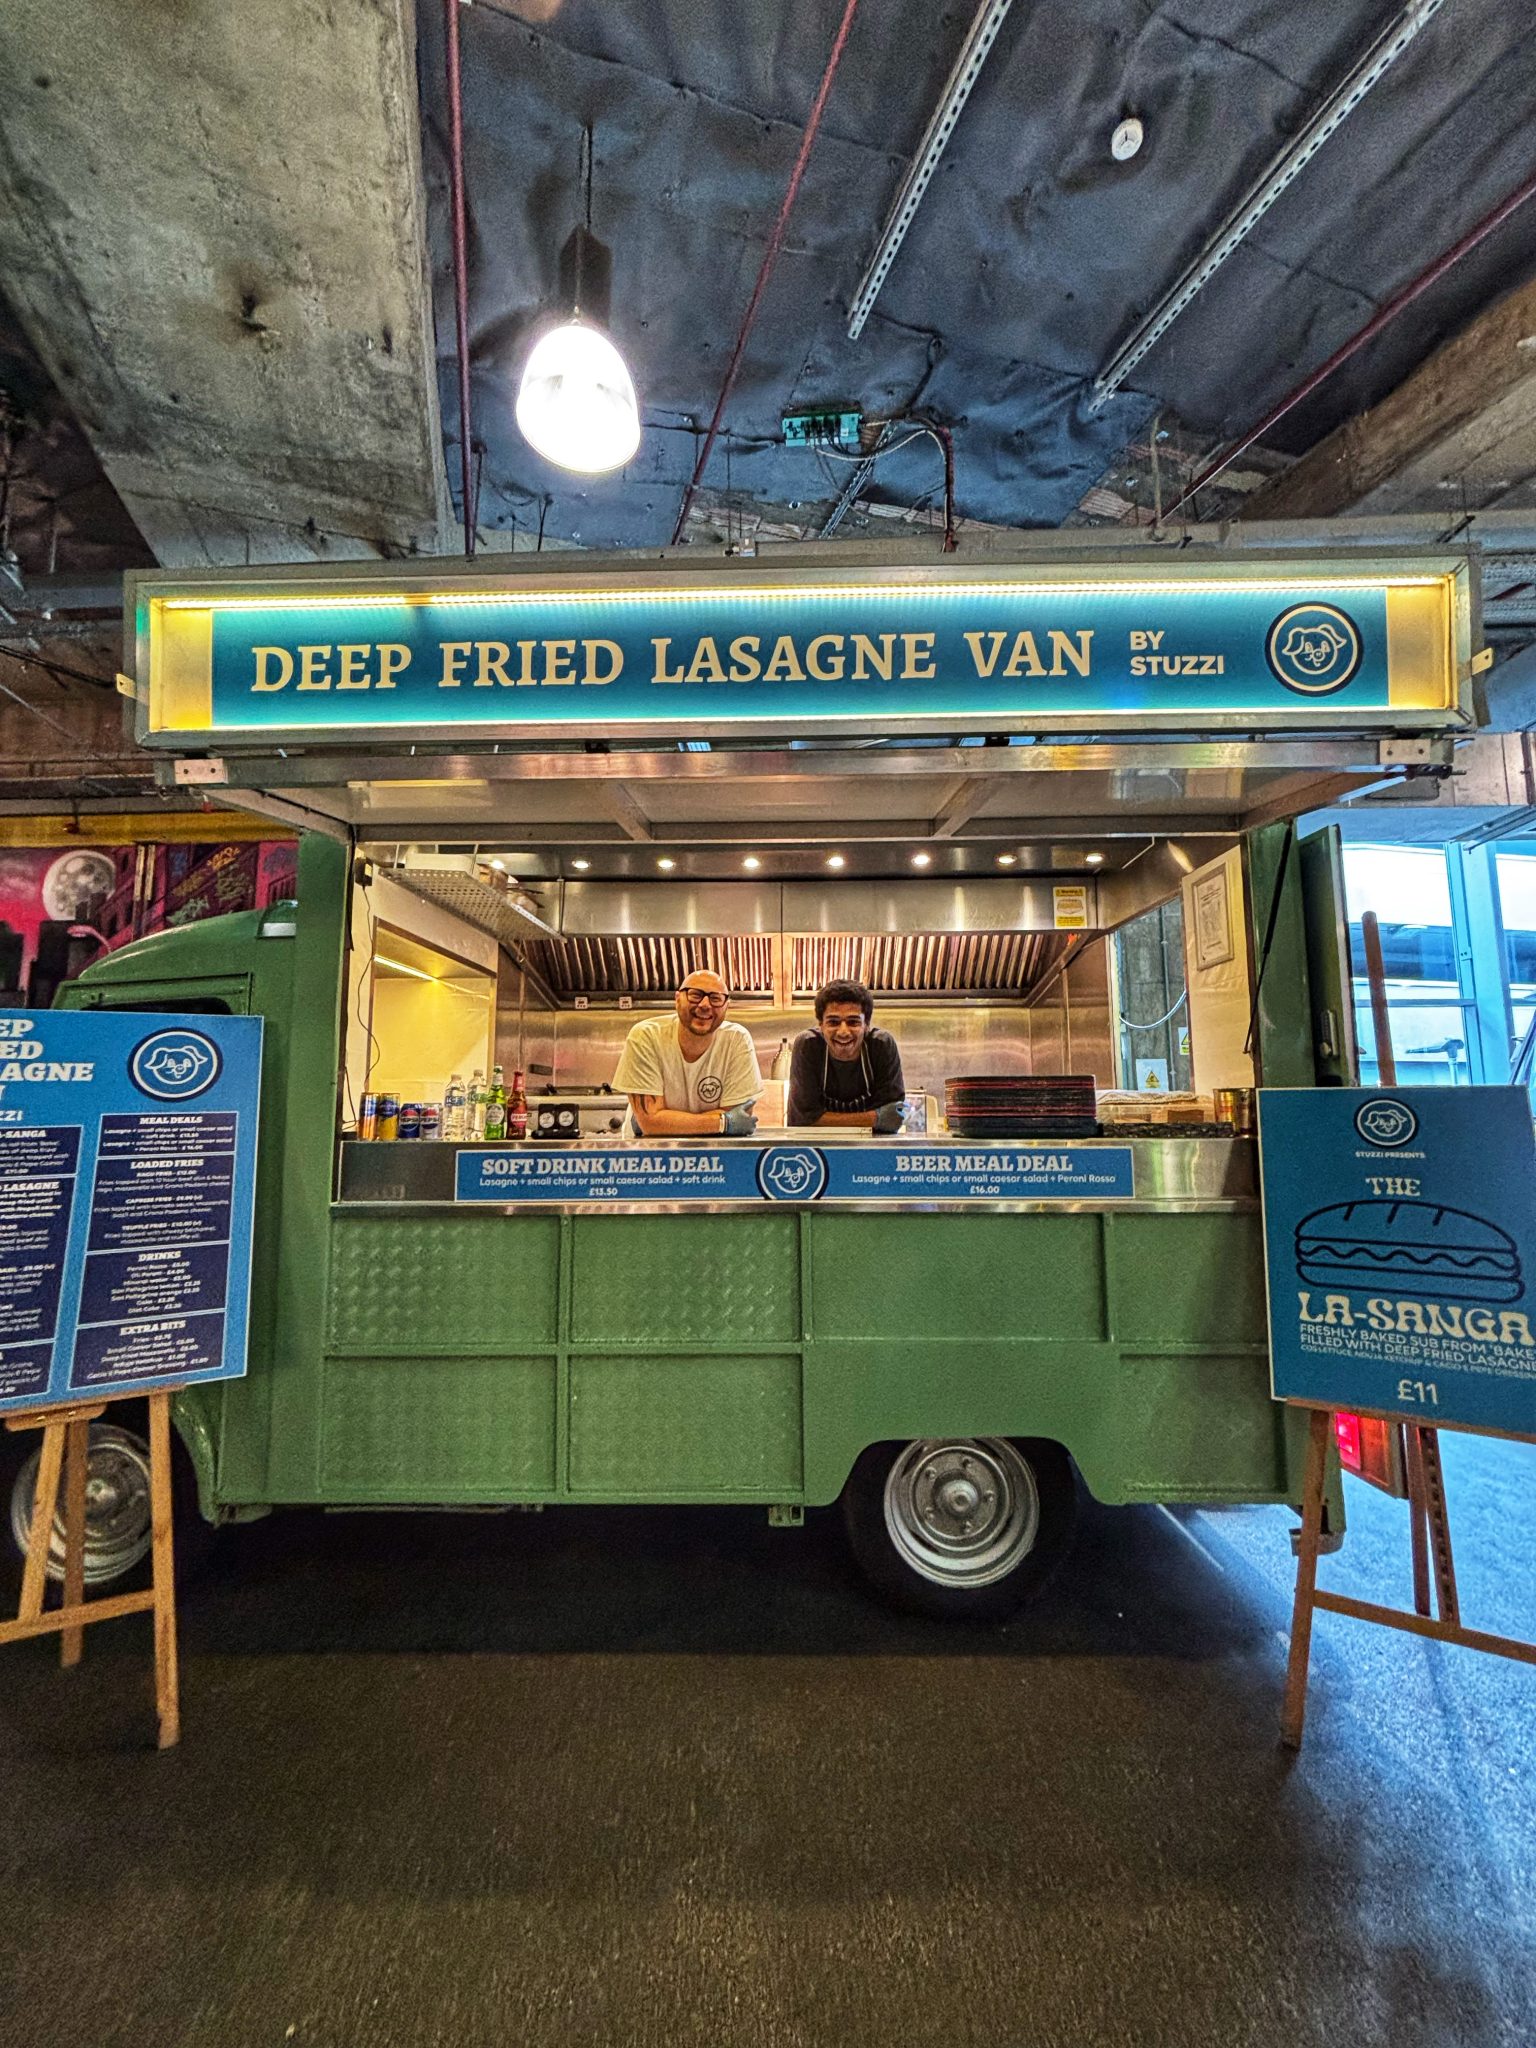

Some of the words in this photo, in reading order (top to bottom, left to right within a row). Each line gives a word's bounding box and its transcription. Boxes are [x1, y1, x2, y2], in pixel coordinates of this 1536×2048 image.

[1129, 630, 1166, 651] BY
[251, 643, 412, 692] DEEP
[438, 639, 625, 688] FRIED
[651, 631, 937, 685] LASAGNE
[963, 630, 1095, 678] VAN
[1129, 655, 1226, 676] STUZZI
[139, 1117, 168, 1125] MEAL
[170, 1116, 203, 1124] DEALS
[0, 1130, 46, 1138] -SANGA
[1385, 1151, 1426, 1159] PRESENTS
[130, 1160, 174, 1169] LOADED
[174, 1159, 204, 1167] FRIES
[482, 1158, 535, 1176] SOFT
[536, 1158, 606, 1175] DRINK
[608, 1157, 666, 1174] MEAL
[669, 1156, 724, 1173] DEAL
[896, 1155, 952, 1172] BEER
[954, 1155, 1013, 1172] MEAL
[1016, 1155, 1073, 1172] DEAL
[2, 1181, 60, 1191] LASAGNE
[480, 1177, 518, 1188] Lasagne
[527, 1177, 552, 1185] small
[553, 1177, 576, 1187] chips
[590, 1176, 614, 1185] small
[616, 1177, 646, 1185] caesar
[648, 1175, 673, 1184] salad
[682, 1175, 700, 1184] soft
[701, 1175, 726, 1184] drink
[852, 1174, 890, 1184] Lasagne
[900, 1174, 924, 1183] small
[926, 1174, 949, 1184] chips
[951, 1175, 961, 1183] or
[964, 1174, 988, 1182] small
[1023, 1174, 1048, 1182] salad
[1058, 1174, 1087, 1182] Peroni
[1089, 1174, 1116, 1183] Rosso
[1365, 1176, 1421, 1196] THE
[589, 1187, 618, 1196] £13.50
[970, 1185, 1000, 1194] £16.00
[138, 1250, 182, 1262] DRINKS
[1298, 1291, 1536, 1346] LA-SANGA
[119, 1323, 159, 1336] EXTRA
[160, 1320, 187, 1330] BITS
[1300, 1323, 1357, 1339] FRESHLY
[1360, 1330, 1407, 1344] BAKED
[1410, 1336, 1439, 1349] SUB
[1442, 1339, 1487, 1354] FROM
[1300, 1333, 1343, 1348] FILLED
[1344, 1339, 1381, 1352] WITH
[1384, 1343, 1420, 1357] DEEP
[1423, 1347, 1465, 1362] FRIED
[1468, 1354, 1536, 1371] LASAGNE
[1398, 1379, 1438, 1405] £11
